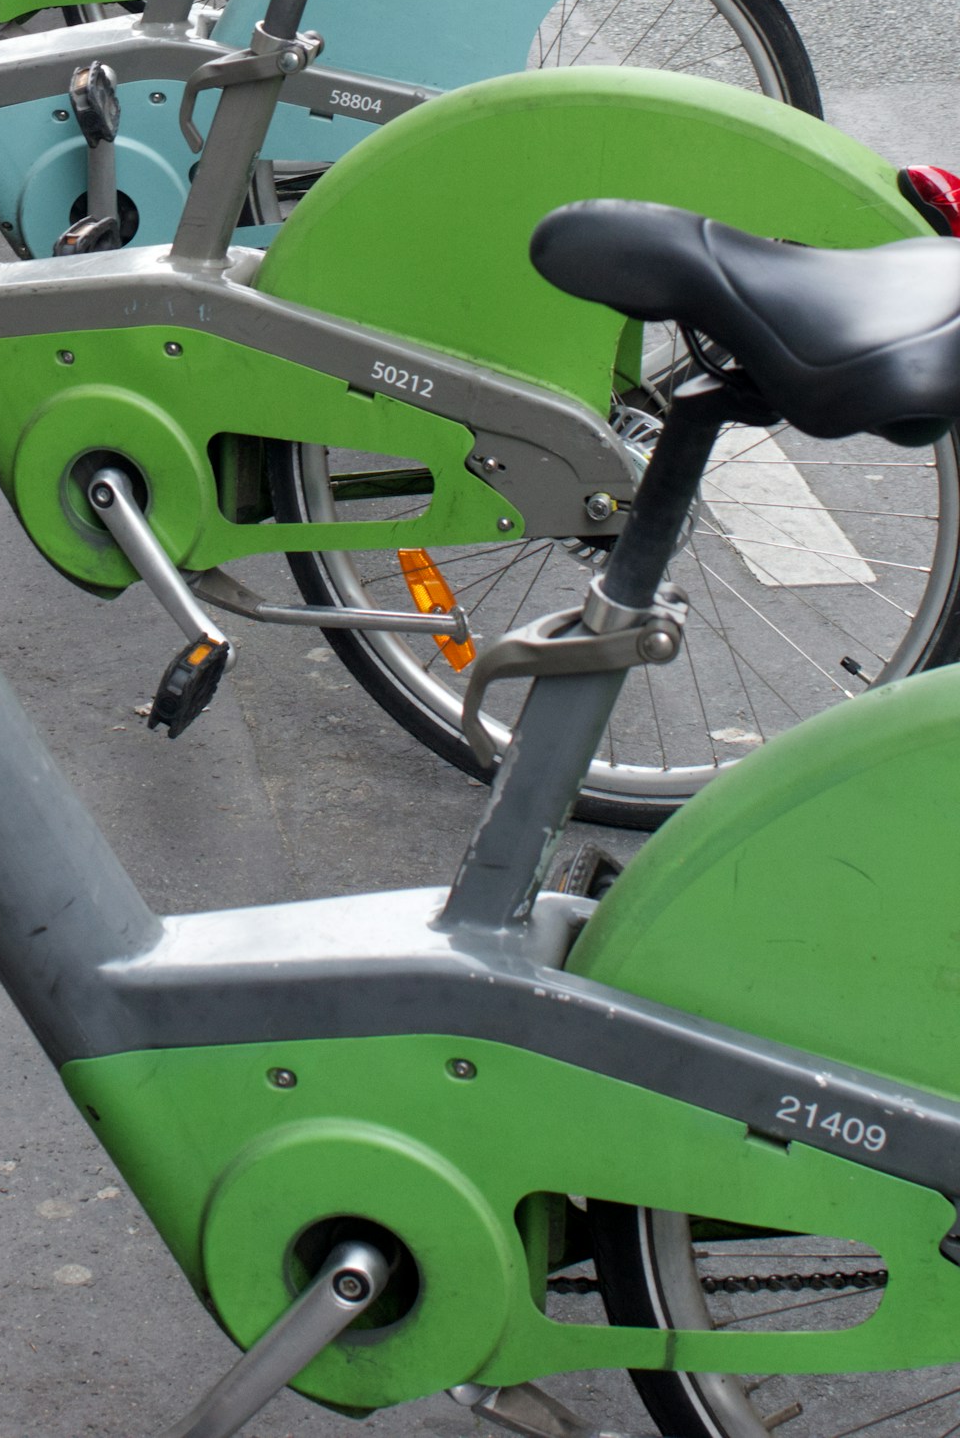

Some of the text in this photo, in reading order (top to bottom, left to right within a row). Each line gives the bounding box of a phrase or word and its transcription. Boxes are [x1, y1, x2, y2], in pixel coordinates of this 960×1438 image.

[329, 89, 382, 114] 58804
[370, 361, 434, 398] 50212
[775, 1095, 887, 1152] 21409
